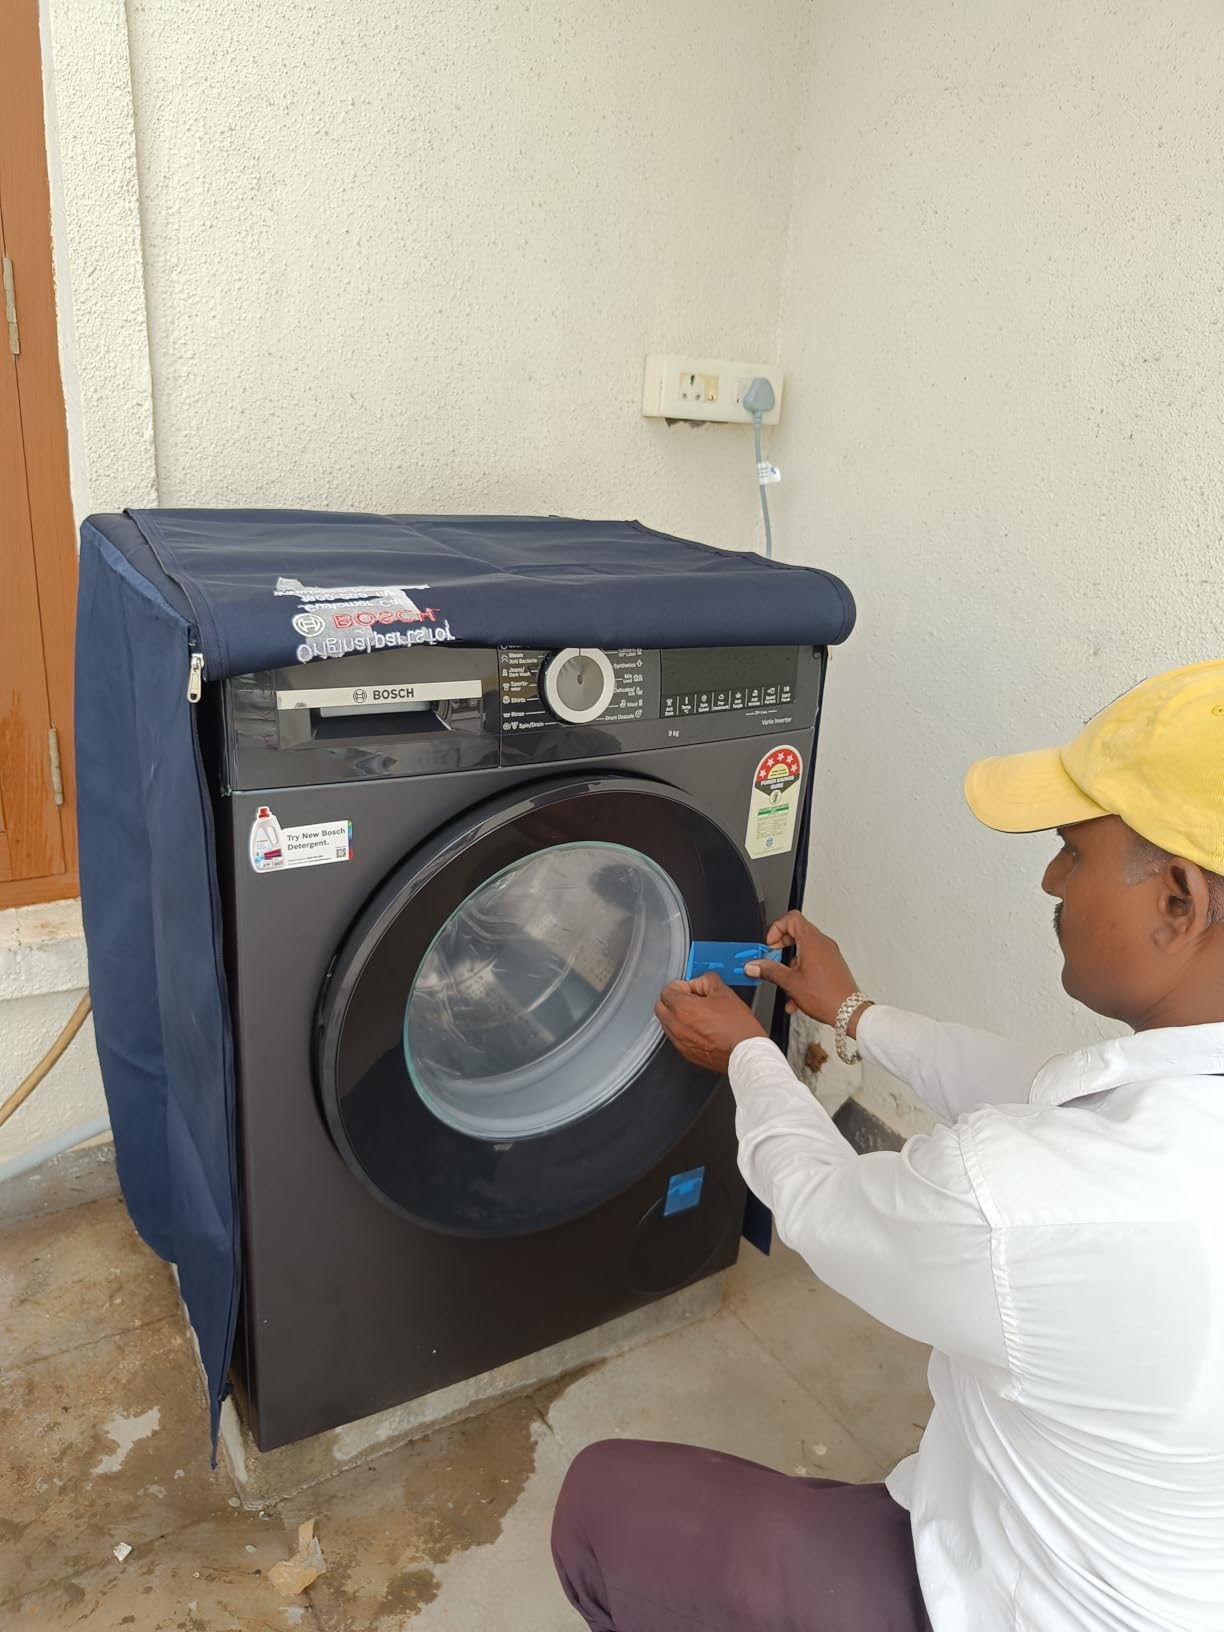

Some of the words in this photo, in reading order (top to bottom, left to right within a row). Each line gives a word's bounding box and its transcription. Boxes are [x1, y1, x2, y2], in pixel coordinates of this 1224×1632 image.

[373, 688, 414, 700] BOSCH
[322, 828, 345, 837] Bosch
[288, 840, 329, 850] Detergent.
